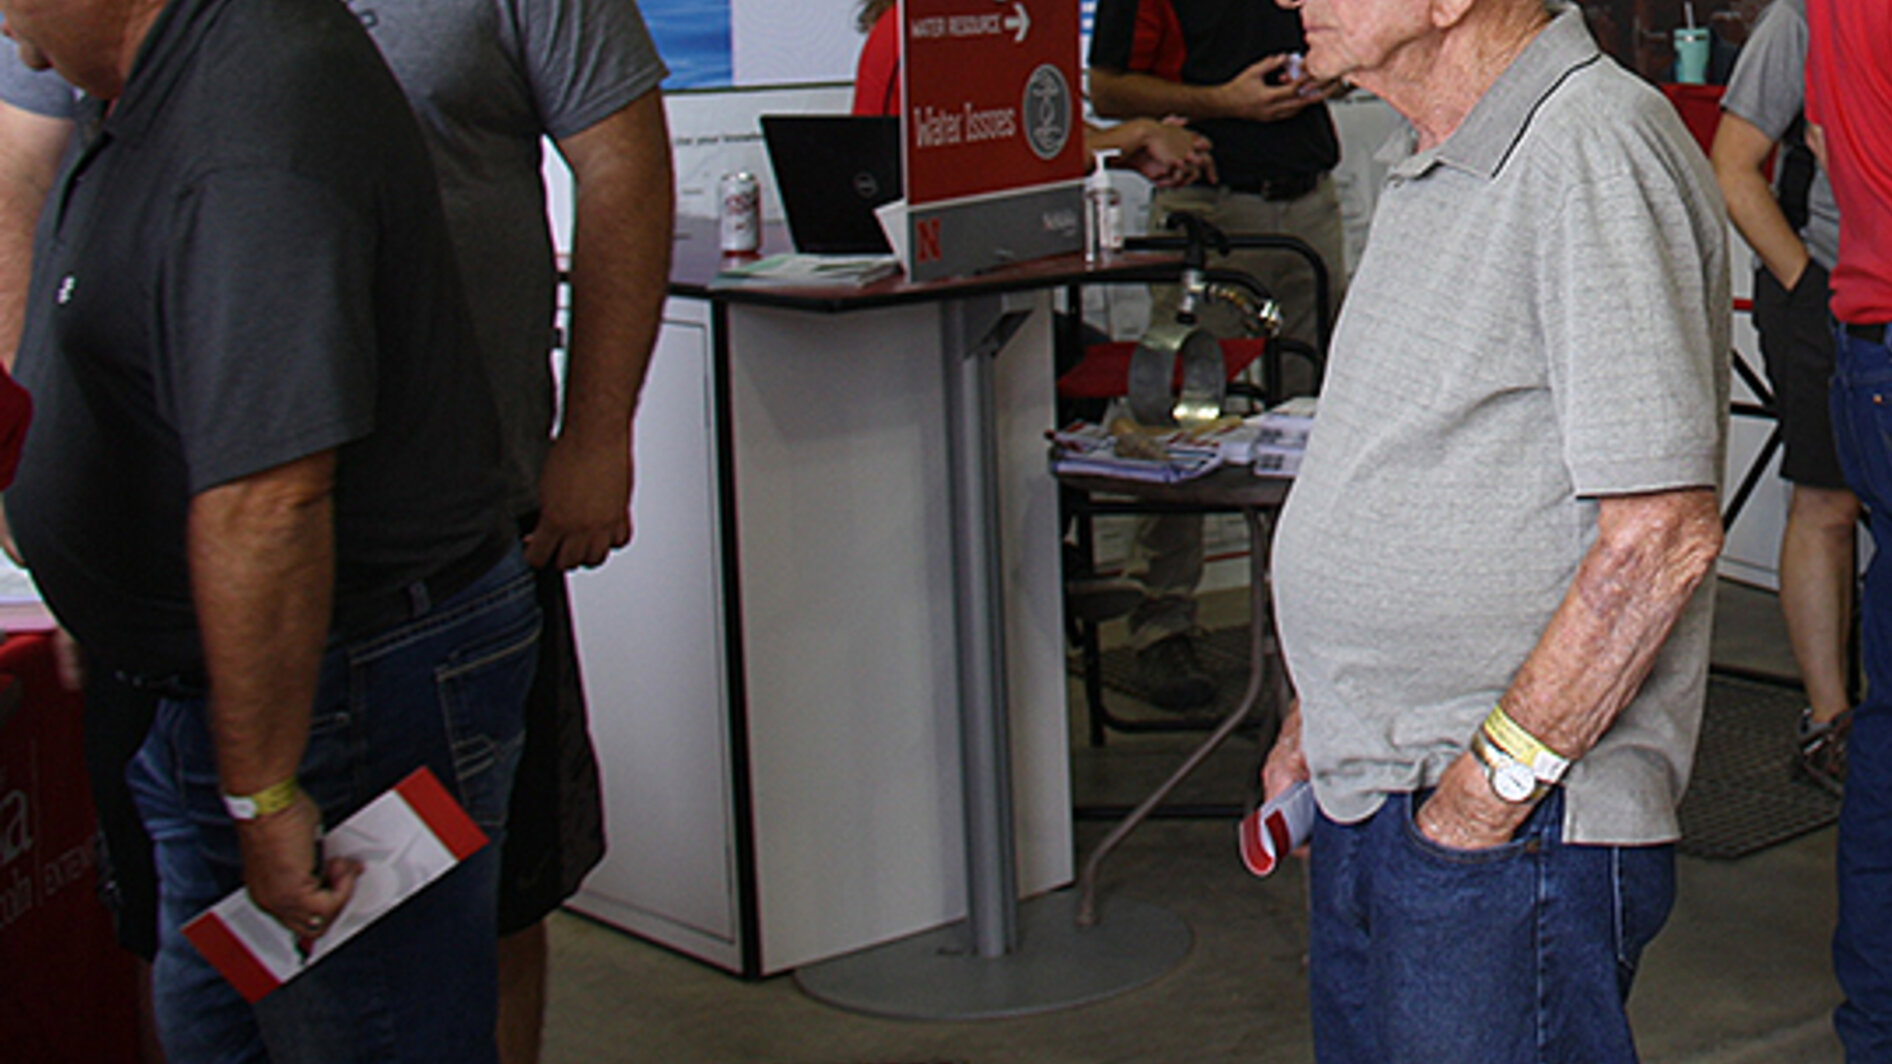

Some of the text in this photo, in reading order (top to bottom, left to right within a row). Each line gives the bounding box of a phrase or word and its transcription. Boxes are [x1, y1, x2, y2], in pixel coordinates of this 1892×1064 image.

[914, 101, 1017, 148] Water Issues
[916, 217, 941, 262] N
